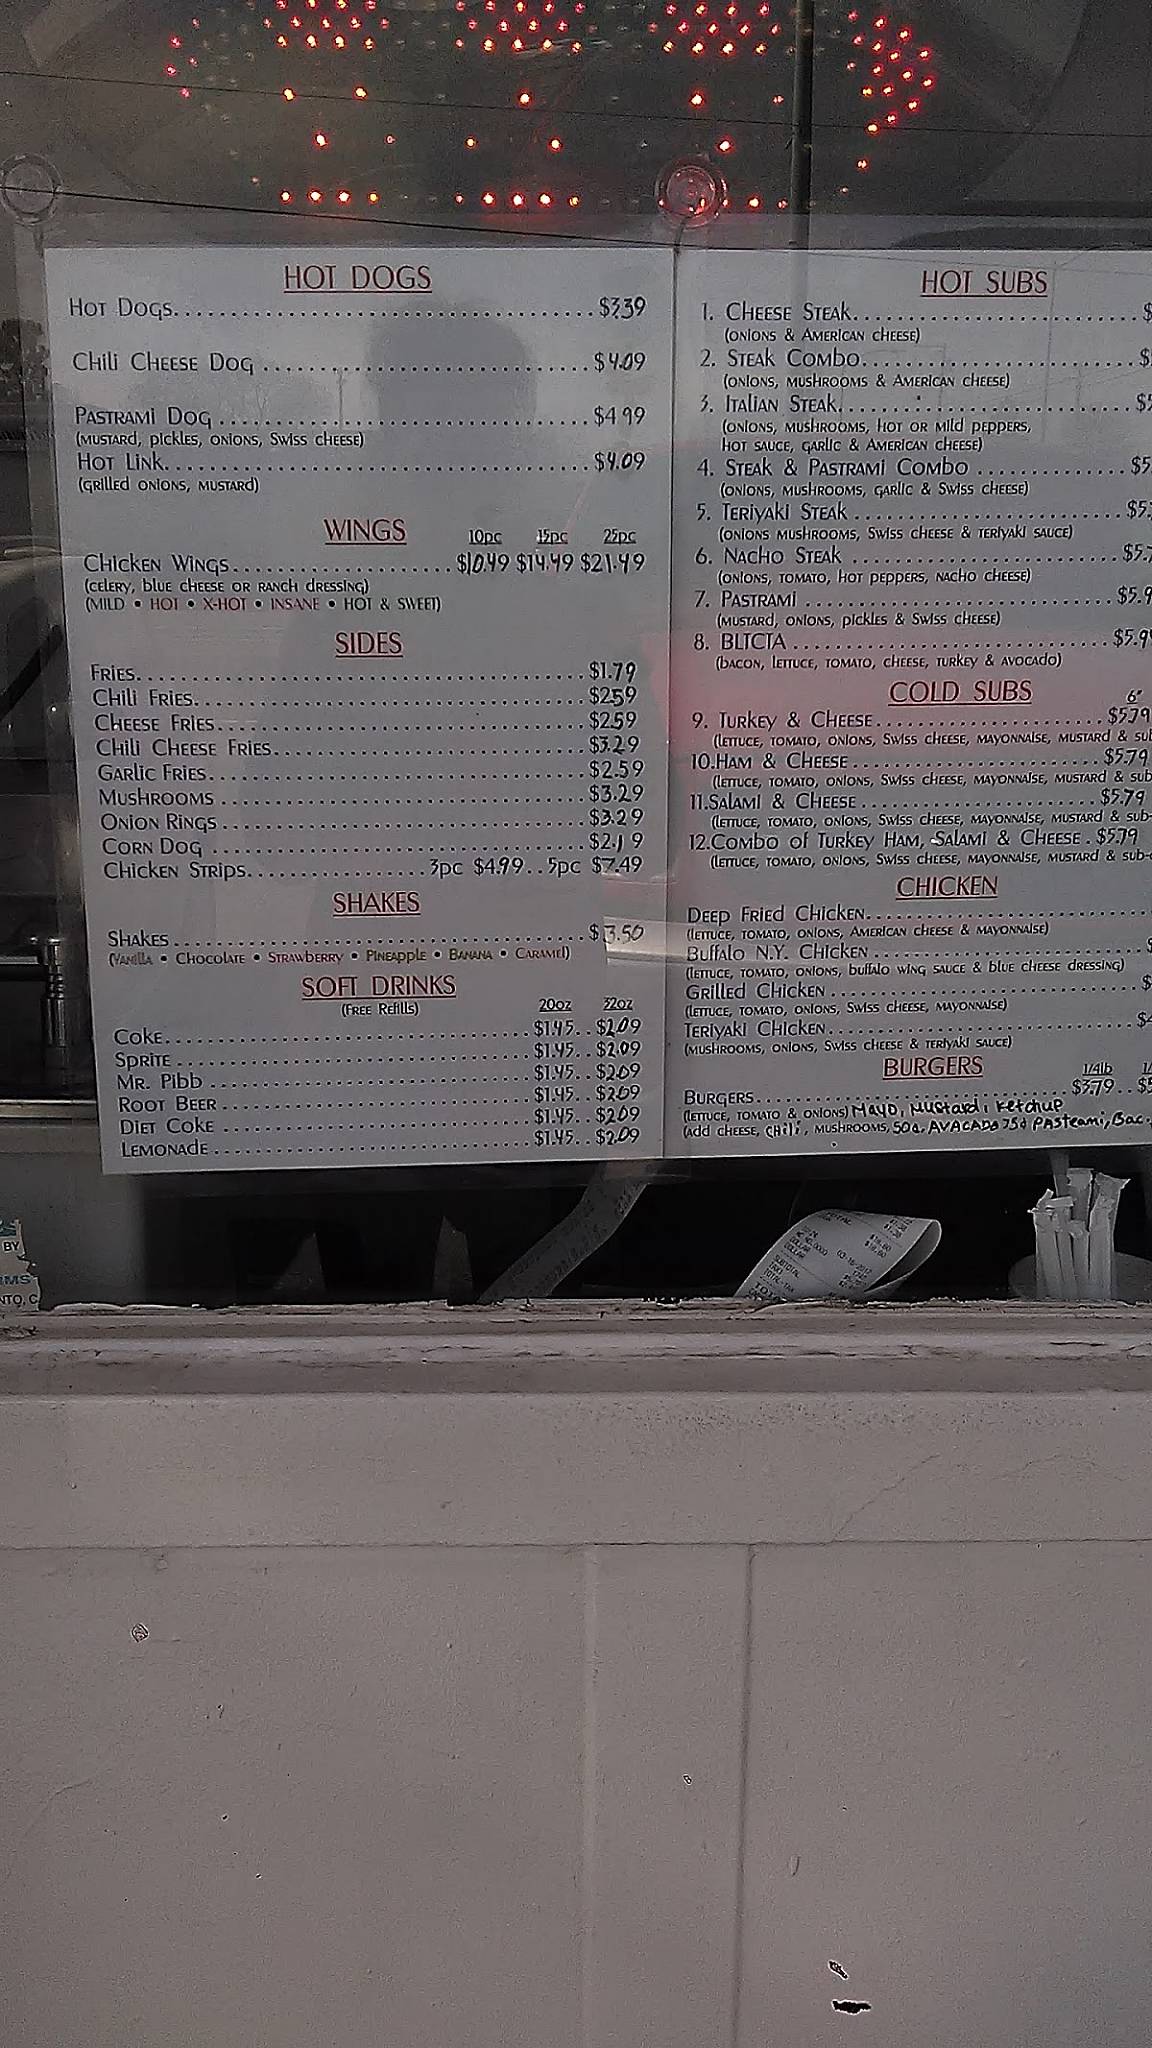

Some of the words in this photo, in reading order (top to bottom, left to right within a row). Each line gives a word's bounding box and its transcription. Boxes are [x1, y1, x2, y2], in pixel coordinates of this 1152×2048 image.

[285, 265, 336, 289] HOT
[352, 265, 431, 289] DOGS
[922, 270, 973, 293] HOT
[987, 271, 1047, 293] SUBS
[70, 298, 107, 316] Hot
[119, 298, 172, 321] Dogs
[726, 301, 792, 321] Cheese
[803, 301, 851, 321] Steak
[785, 328, 794, 341] &
[801, 328, 864, 341] American
[73, 351, 117, 371] Chili
[131, 351, 198, 371] Cheese
[210, 353, 253, 376] Dog
[728, 347, 775, 367] Steak
[787, 347, 859, 367] Combo
[787, 373, 868, 387] mushrooms
[876, 374, 885, 387] &
[893, 374, 955, 387] American
[726, 393, 778, 412] Italian
[789, 393, 837, 412] Steak
[76, 406, 155, 424] Pastrami
[168, 407, 211, 430] Dog
[271, 432, 307, 446] Swiss
[78, 452, 114, 470] Hot
[126, 451, 164, 471] Link
[726, 457, 772, 476] Steak
[784, 458, 797, 476] &
[809, 458, 885, 476] Pastrami
[897, 456, 968, 476] Combo
[722, 501, 789, 525] Teriyaki
[801, 501, 847, 520] Steak
[324, 519, 405, 541] WINGS
[469, 530, 502, 545] 10pc
[537, 529, 568, 545] 15pc
[604, 529, 636, 545] 25pc
[725, 545, 783, 564] Nacho
[796, 545, 841, 564] Steak
[84, 553, 161, 572] Chicken
[171, 555, 229, 576] Wings
[143, 578, 172, 592] blue
[180, 578, 224, 592] cheese
[232, 582, 250, 592] or
[259, 578, 298, 592] ranch
[722, 590, 796, 607] Pastrami
[336, 632, 401, 654] SIDES
[936, 653, 978, 669] turkey
[985, 654, 994, 666] &
[91, 664, 135, 681] Fries
[93, 688, 136, 706] Chili
[149, 689, 192, 706] Fries
[890, 681, 959, 702] COLD
[974, 680, 1031, 701] SUBS
[95, 713, 160, 731] Cheese
[172, 714, 214, 731] Fries
[719, 710, 777, 732] Turkey
[787, 712, 800, 728] &
[811, 710, 872, 728] Cheese
[96, 738, 140, 756] Chili
[152, 738, 216, 756] Cheese
[229, 739, 271, 756] Fries
[98, 763, 156, 781] Garlic
[163, 764, 206, 781] Fries
[99, 787, 213, 805] Mushrooms
[101, 813, 159, 830] Onion
[167, 813, 216, 833] Rings
[103, 838, 153, 855] Corn
[160, 838, 202, 858] Dog
[104, 860, 178, 879] Chicken
[190, 862, 246, 881] Strips
[430, 859, 463, 879] 3pc
[549, 857, 581, 878] 5pc
[897, 876, 997, 896] CHICKEN
[334, 892, 419, 913] SHAKES
[688, 907, 730, 927] Deep
[742, 904, 784, 922] Fried
[796, 904, 864, 921] Chicken
[108, 929, 169, 947] Shakes
[176, 951, 245, 964] Chocolate
[269, 950, 344, 965] Strawberry
[366, 948, 426, 964] Pineapple
[449, 948, 493, 960] Banana
[687, 944, 744, 961] Buffalo
[757, 944, 788, 960] N.Y.
[800, 942, 868, 959] Chicken
[302, 977, 358, 997] SOFT
[373, 975, 455, 995] DRINKS
[686, 982, 745, 999] Grilled
[757, 981, 825, 998] Chicken
[539, 999, 572, 1012] 20oz
[603, 997, 633, 1011] 32oz
[114, 1027, 162, 1045] Coke
[684, 1021, 746, 1041] Teriyaki
[758, 1019, 825, 1036] Chicken
[115, 1052, 171, 1071] Sprite
[884, 1056, 982, 1076] BURGERS
[1082, 1062, 1112, 1076] 1/4lb
[118, 1075, 150, 1089] Mr.
[161, 1072, 202, 1089] Pibb
[119, 1097, 165, 1112] Root
[176, 1096, 216, 1111] Beer
[685, 1090, 754, 1107] Burgers
[121, 1120, 156, 1134] Diet
[167, 1117, 214, 1133] Coke
[122, 1139, 208, 1157] Lemonade
